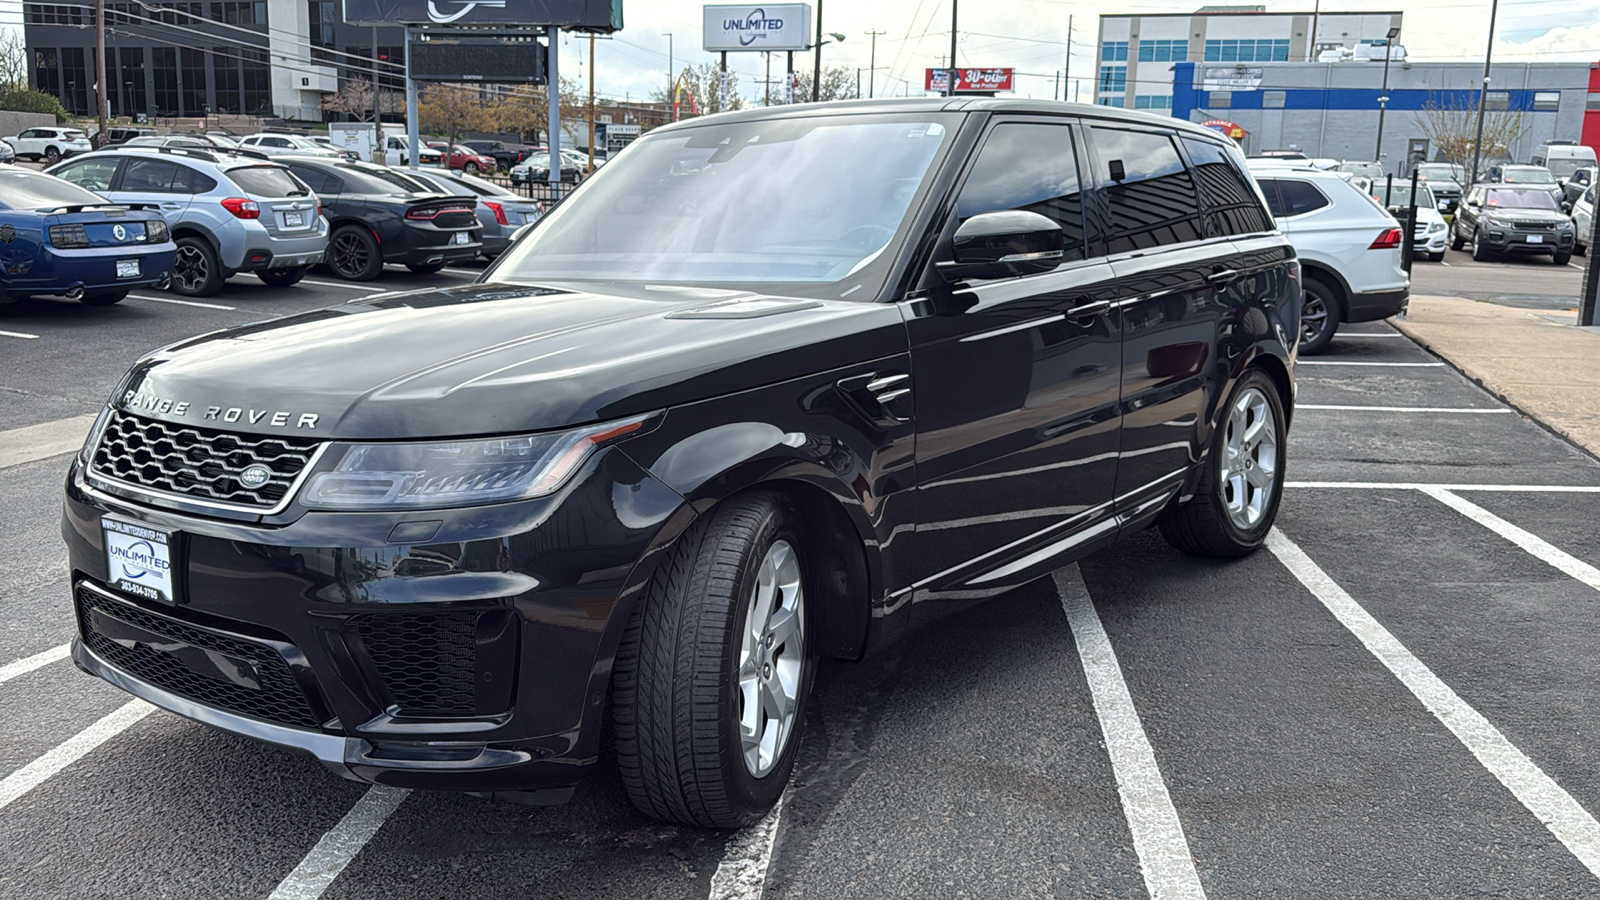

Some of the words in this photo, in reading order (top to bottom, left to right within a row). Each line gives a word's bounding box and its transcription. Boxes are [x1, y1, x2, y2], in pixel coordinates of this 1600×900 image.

[723, 19, 784, 30] UNLIMITED
[123, 389, 191, 416] RANGE
[203, 405, 320, 429] ROVER
[246, 475, 264, 483] ROVER
[110, 545, 171, 570] UNLIMITED
[121, 580, 158, 600] 303-934-3705
